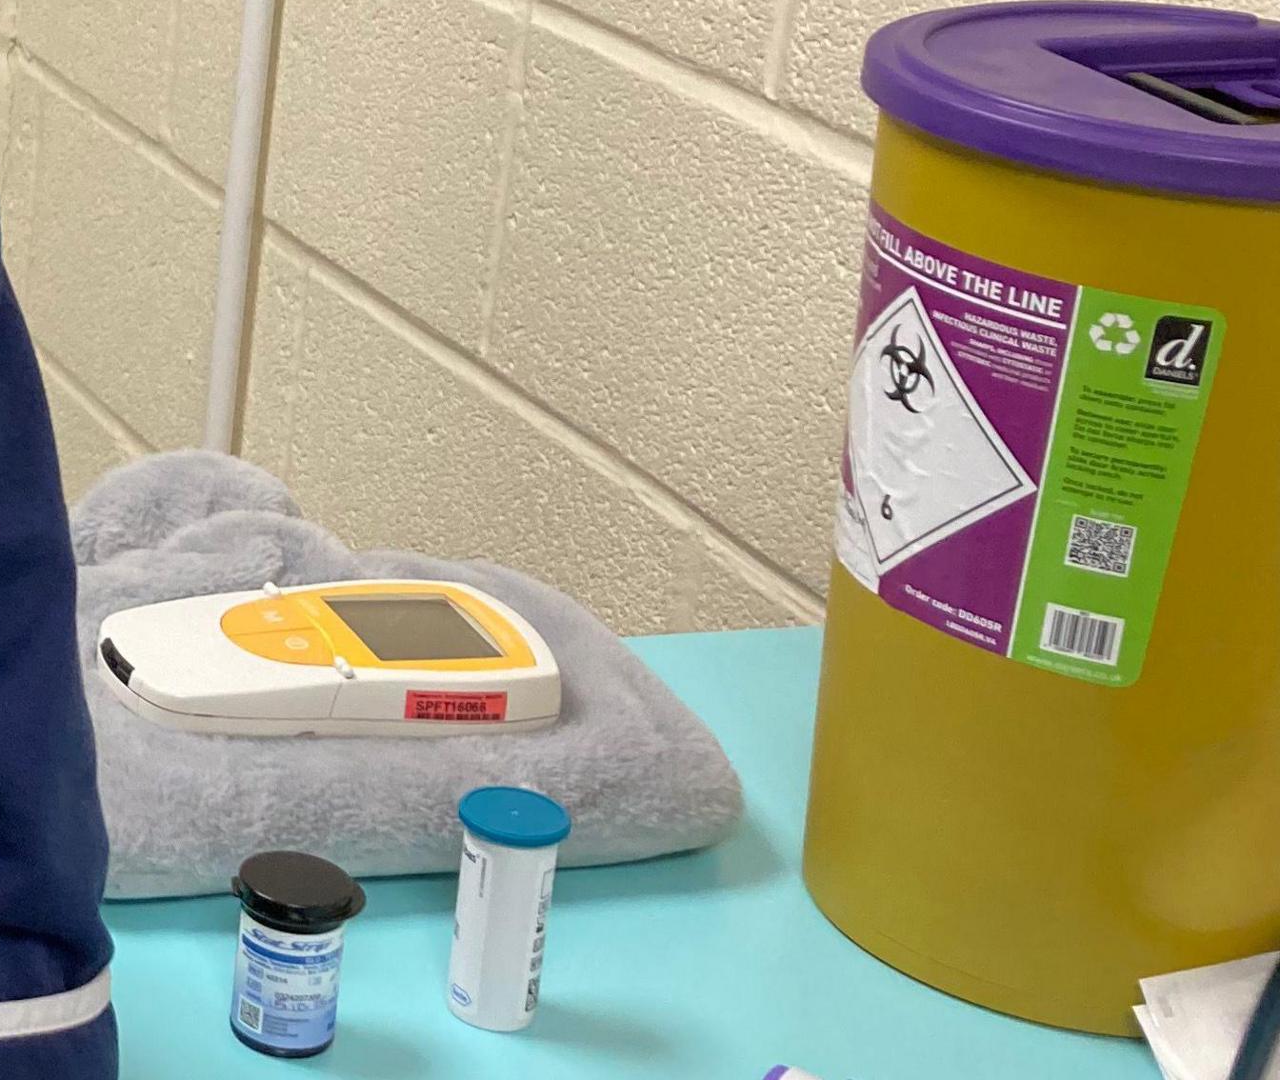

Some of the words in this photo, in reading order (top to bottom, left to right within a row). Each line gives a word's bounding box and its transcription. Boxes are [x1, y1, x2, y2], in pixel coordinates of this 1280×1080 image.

[880, 228, 902, 258] FILL
[904, 245, 959, 285] ABOVE
[962, 270, 1003, 301] THE
[1008, 287, 1064, 318] LINE
[932, 310, 978, 335] INFECTIOUS
[980, 328, 1019, 348] CLINICAL
[1021, 341, 1057, 357] WASTE
[964, 312, 1019, 336] HAZARDOUS
[881, 494, 893, 520] 6
[905, 584, 930, 602] Order
